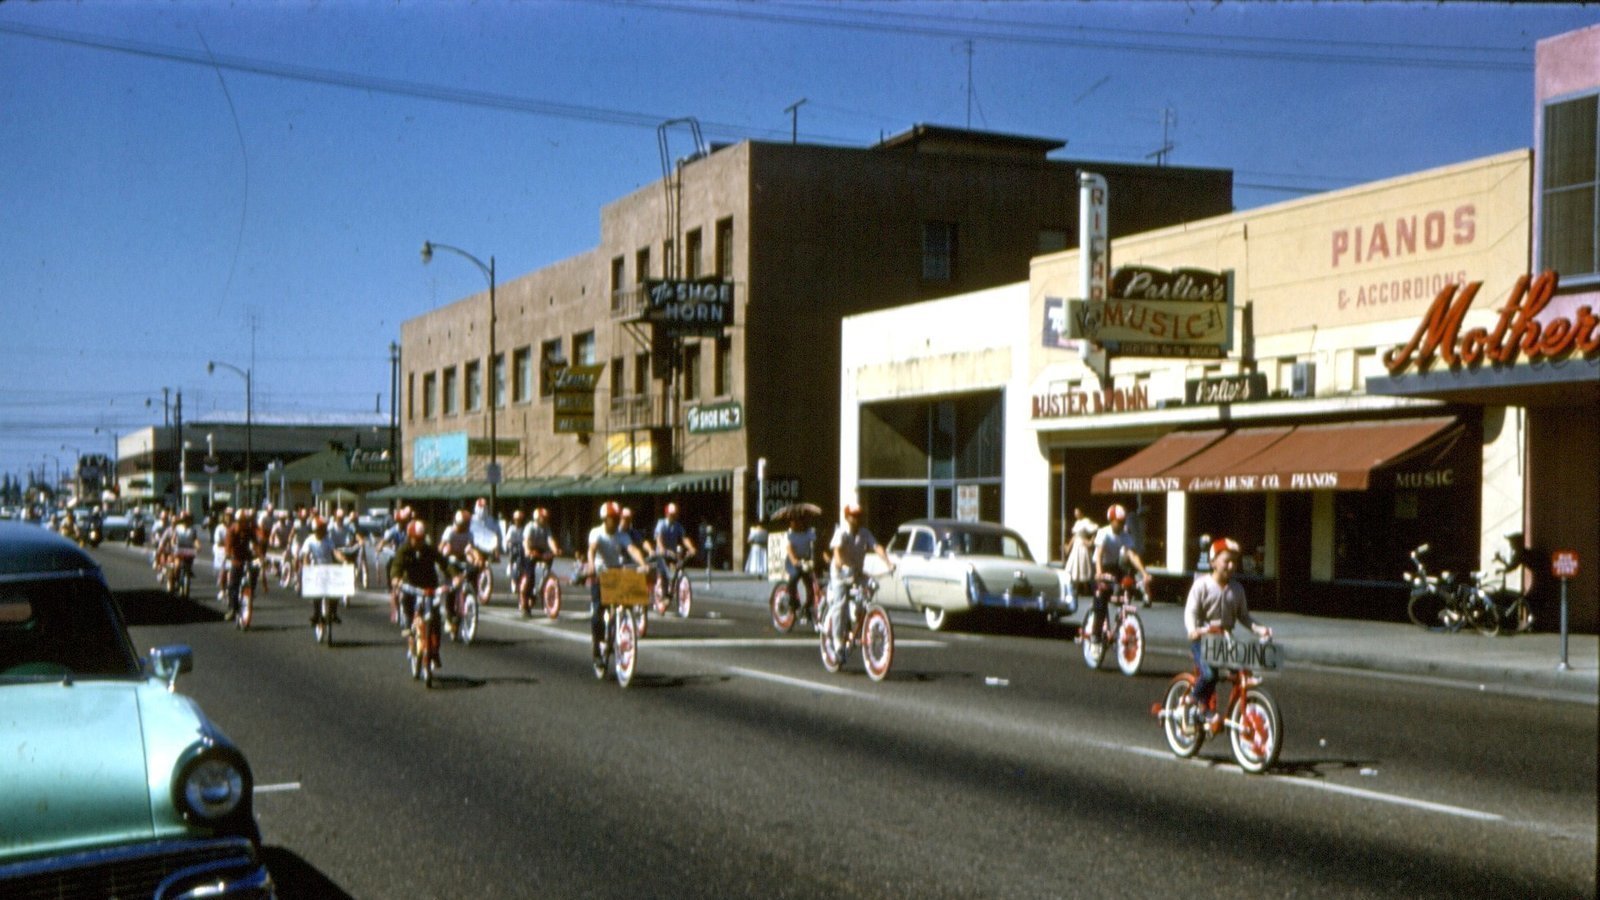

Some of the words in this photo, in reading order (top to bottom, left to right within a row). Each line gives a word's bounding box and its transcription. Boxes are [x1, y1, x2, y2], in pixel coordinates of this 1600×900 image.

[1331, 204, 1476, 268] PIANOS
[676, 283, 730, 303] SHOE
[1338, 289, 1350, 310] &
[1356, 270, 1467, 309] ACCORDIONS
[664, 302, 724, 321] HORN
[1103, 303, 1205, 340] MUSIC
[1032, 389, 1088, 418] BUSTER
[1112, 476, 1180, 491] INSTRUMENTS
[1223, 475, 1259, 489] MUSIC
[1290, 472, 1338, 489] PIANOS
[1396, 469, 1453, 488] MUSIC
